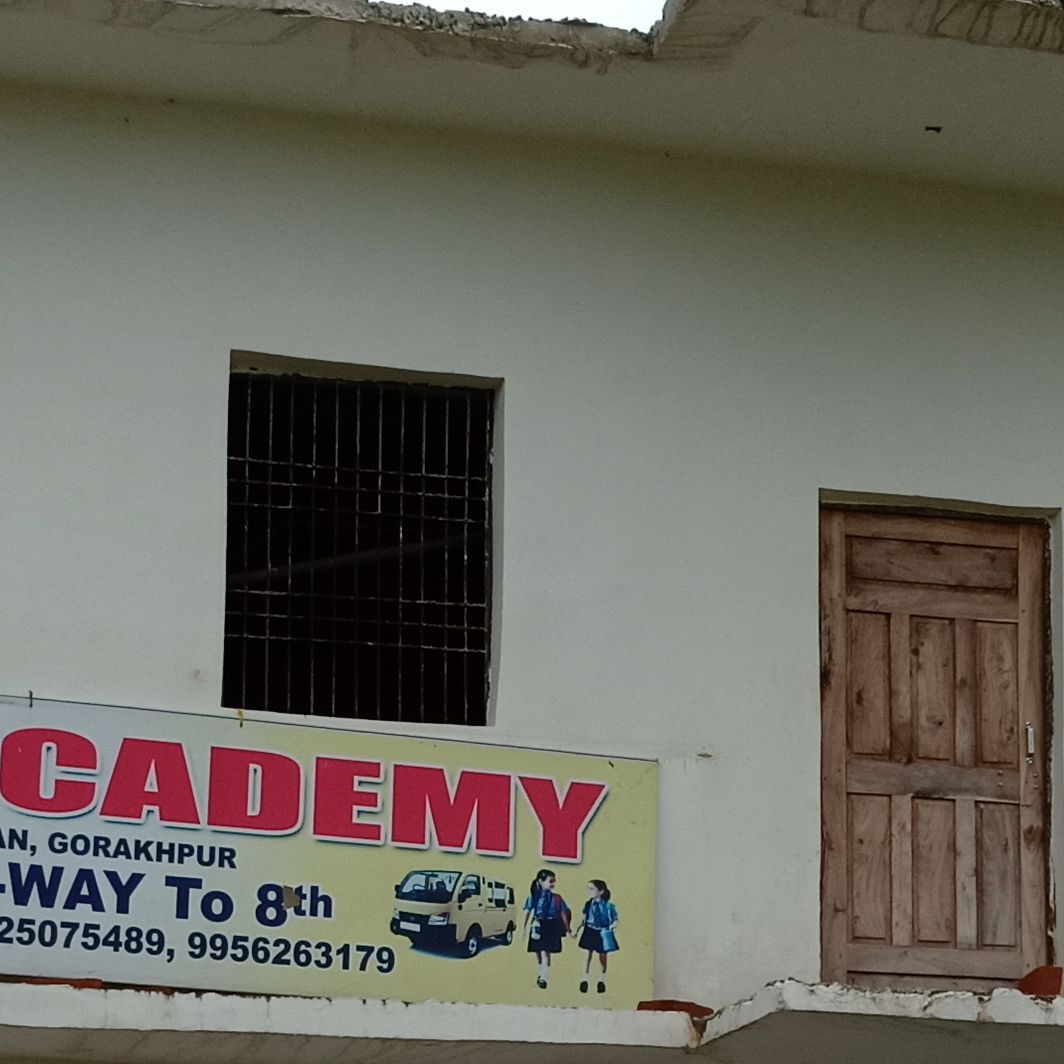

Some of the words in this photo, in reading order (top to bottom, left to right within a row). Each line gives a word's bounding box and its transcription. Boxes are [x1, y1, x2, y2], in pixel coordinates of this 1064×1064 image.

[47, 832, 238, 869] GORAKHPUR
[164, 875, 234, 923] To
[254, 883, 333, 928] 8th
[187, 931, 396, 974] 9956263179
